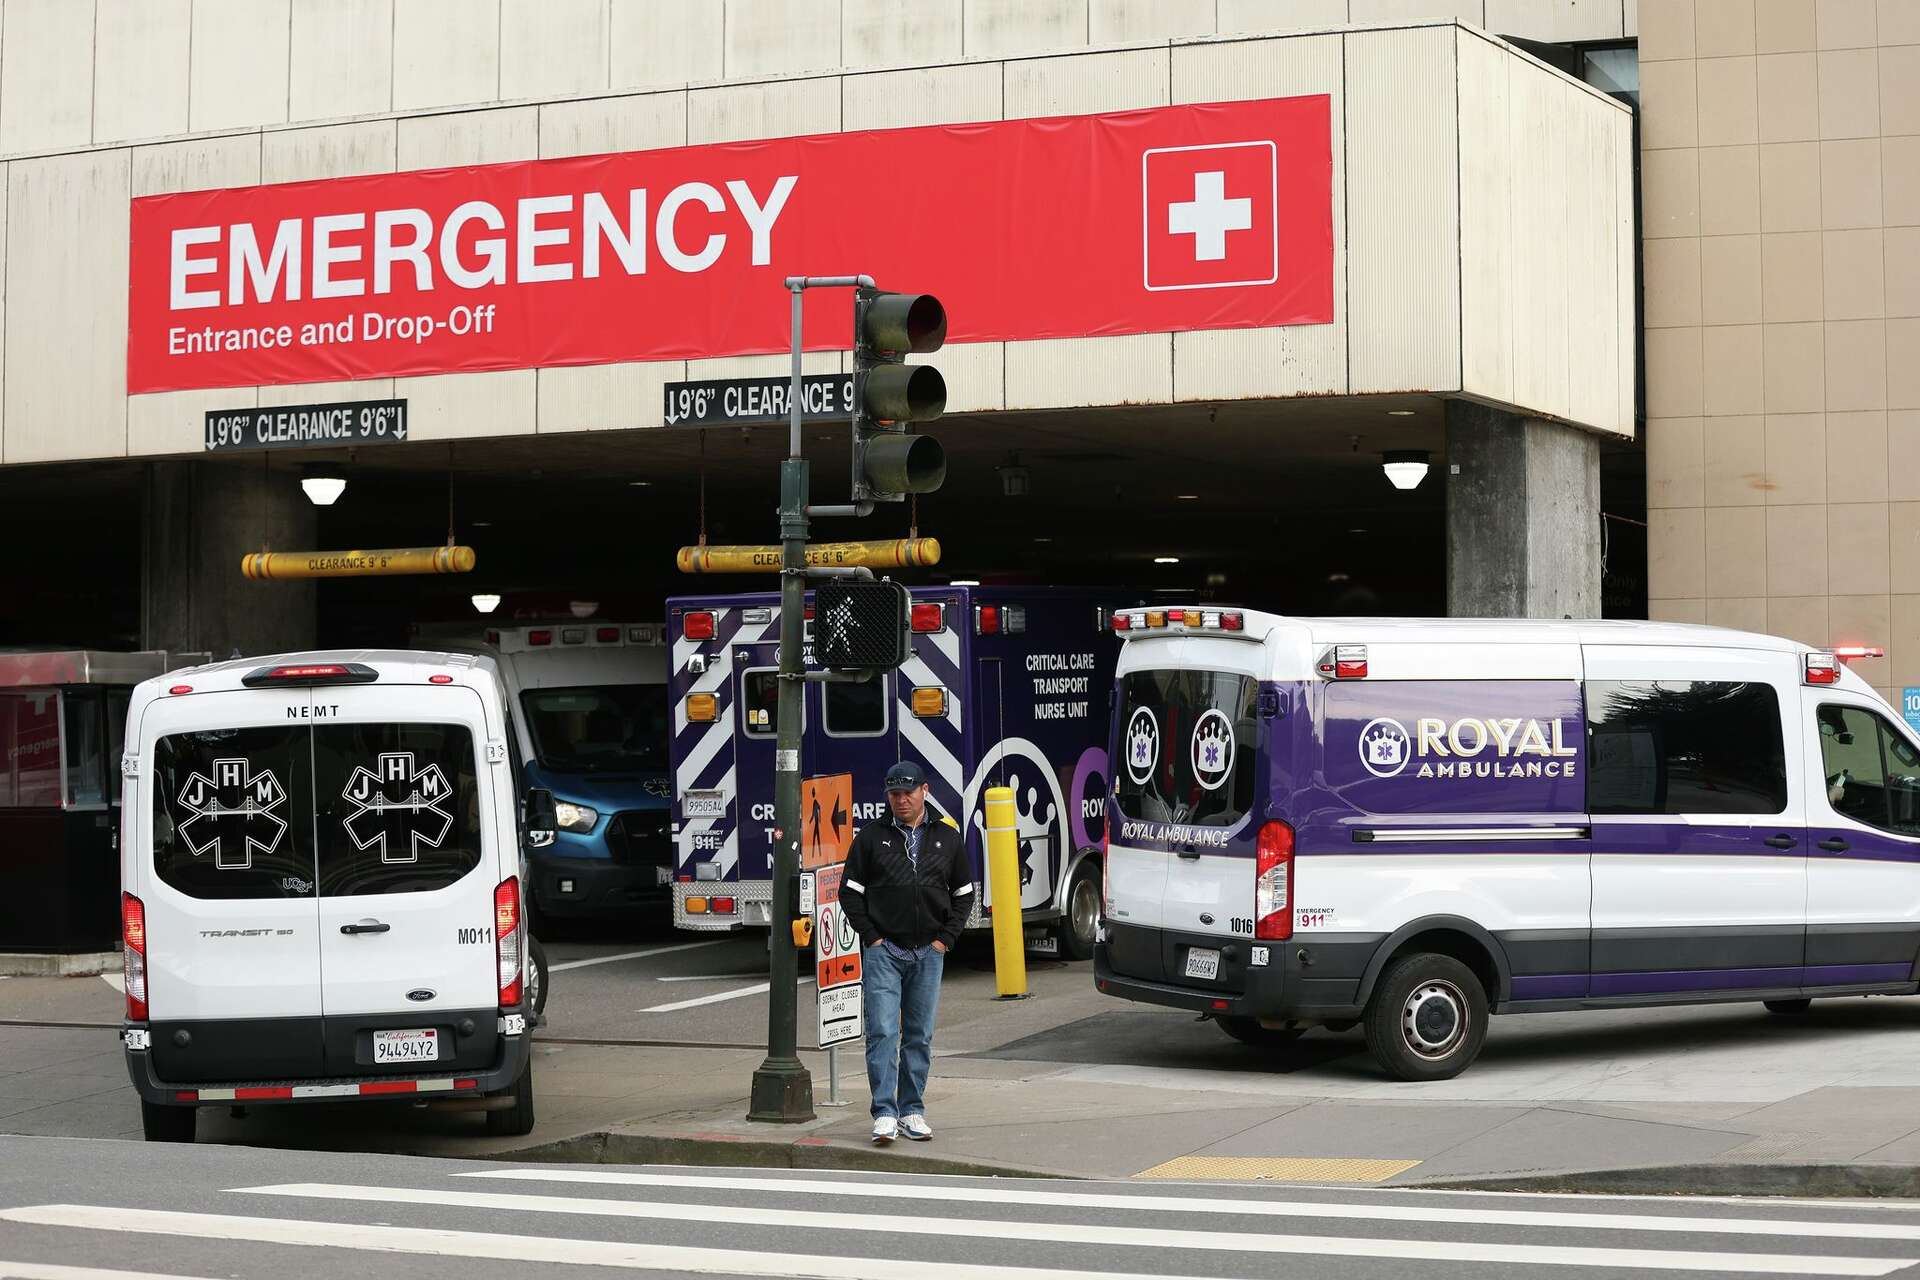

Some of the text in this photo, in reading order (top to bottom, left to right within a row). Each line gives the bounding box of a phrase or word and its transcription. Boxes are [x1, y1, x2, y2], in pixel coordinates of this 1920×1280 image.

[169, 175, 799, 311] EMERGENCY
[168, 304, 496, 355] Entrance and Drop-Off
[256, 409, 353, 443] CLEARANCE
[308, 557, 366, 570] CLEARANCE
[753, 552, 819, 566] CLEACE
[1026, 653, 1095, 671] CRITICAL CARE
[1033, 677, 1088, 695] TRANSPORT
[287, 705, 339, 718] NEMT
[1034, 701, 1088, 720] NURSE UNIT
[1417, 717, 1578, 758] ROYAL
[1416, 761, 1577, 779] AMBULANCE
[852, 802, 886, 819] ARE
[1081, 798, 1105, 818] ROY
[695, 836, 714, 849] 911
[1121, 822, 1230, 848] ROYAL AMBULANCE
[1230, 917, 1253, 934] 1016
[1302, 914, 1324, 927] 911
[199, 928, 273, 938] TRANSIT
[458, 927, 491, 945] M011
[379, 1041, 434, 1058] 94494Y2
